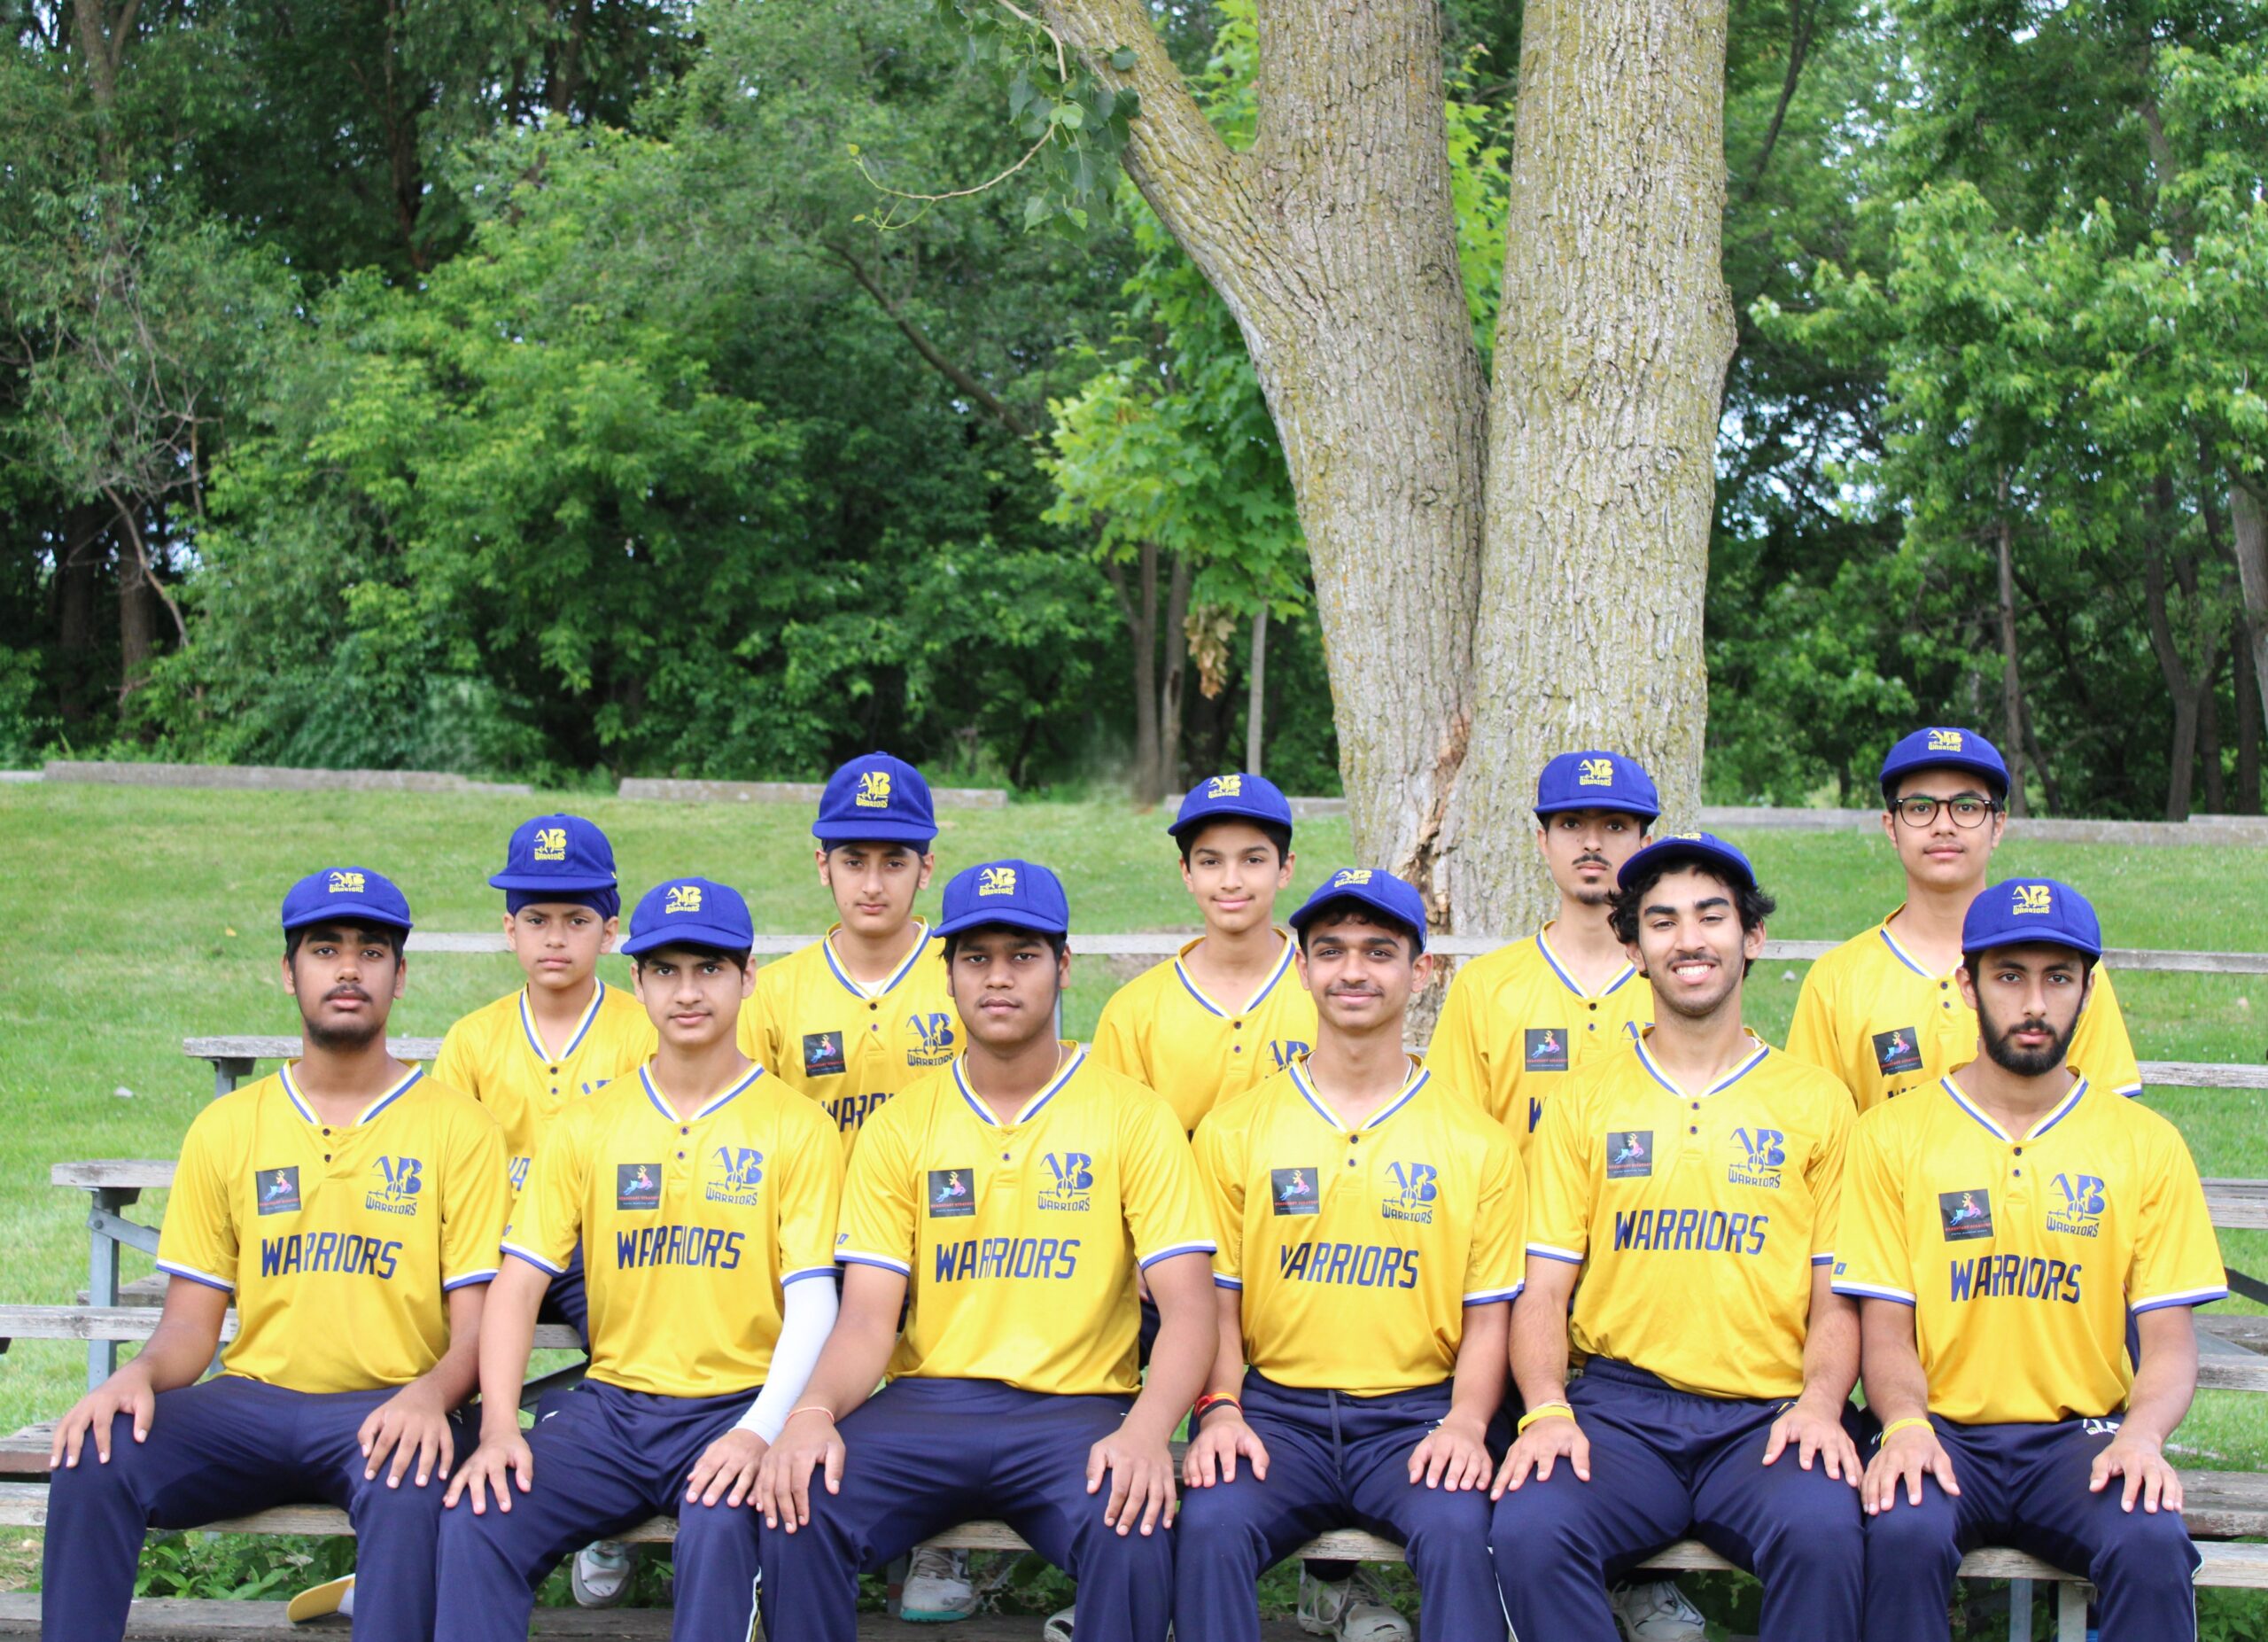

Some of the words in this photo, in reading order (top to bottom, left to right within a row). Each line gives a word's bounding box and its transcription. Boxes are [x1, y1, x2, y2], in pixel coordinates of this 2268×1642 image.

[906, 1049, 953, 1067] WARRIORS
[821, 1092, 894, 1132] ARR
[1728, 1166, 1781, 1189] WARRIORS
[365, 1194, 417, 1217] WARRIORS
[705, 1185, 758, 1206] WARRIORS
[1037, 1194, 1090, 1212] WARRIORS
[1381, 1201, 1433, 1225] WARRIORS
[2046, 1212, 2100, 1238] WARRIORS
[1613, 1209, 1768, 1256] WARRIORS
[262, 1231, 403, 1280] WARRIORS
[617, 1225, 746, 1270] WARRIORS
[935, 1237, 1081, 1283] WARRIORS
[1950, 1253, 2082, 1304] WARRIORS
